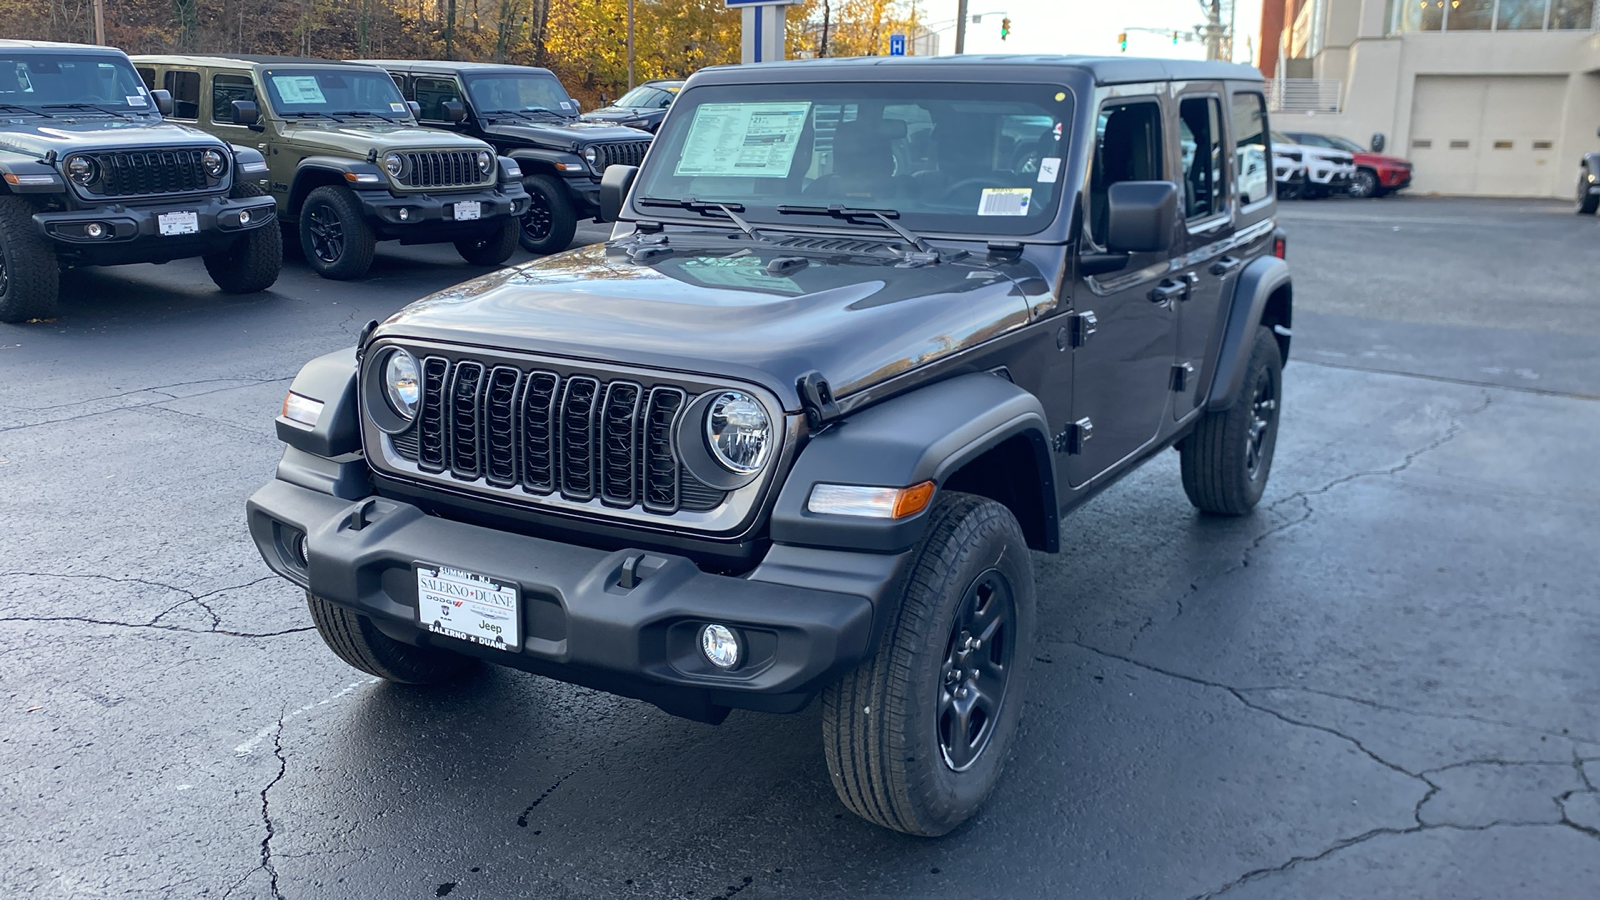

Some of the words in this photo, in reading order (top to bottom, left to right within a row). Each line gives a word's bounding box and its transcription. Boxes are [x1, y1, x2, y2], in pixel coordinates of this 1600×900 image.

[893, 40, 903, 54] H
[479, 575, 491, 584] NJ
[421, 577, 469, 598] SALERNO
[475, 589, 514, 608] DUANE
[478, 620, 502, 634] Jeep
[428, 624, 467, 640] SALERNO
[478, 637, 507, 651] DUANE
